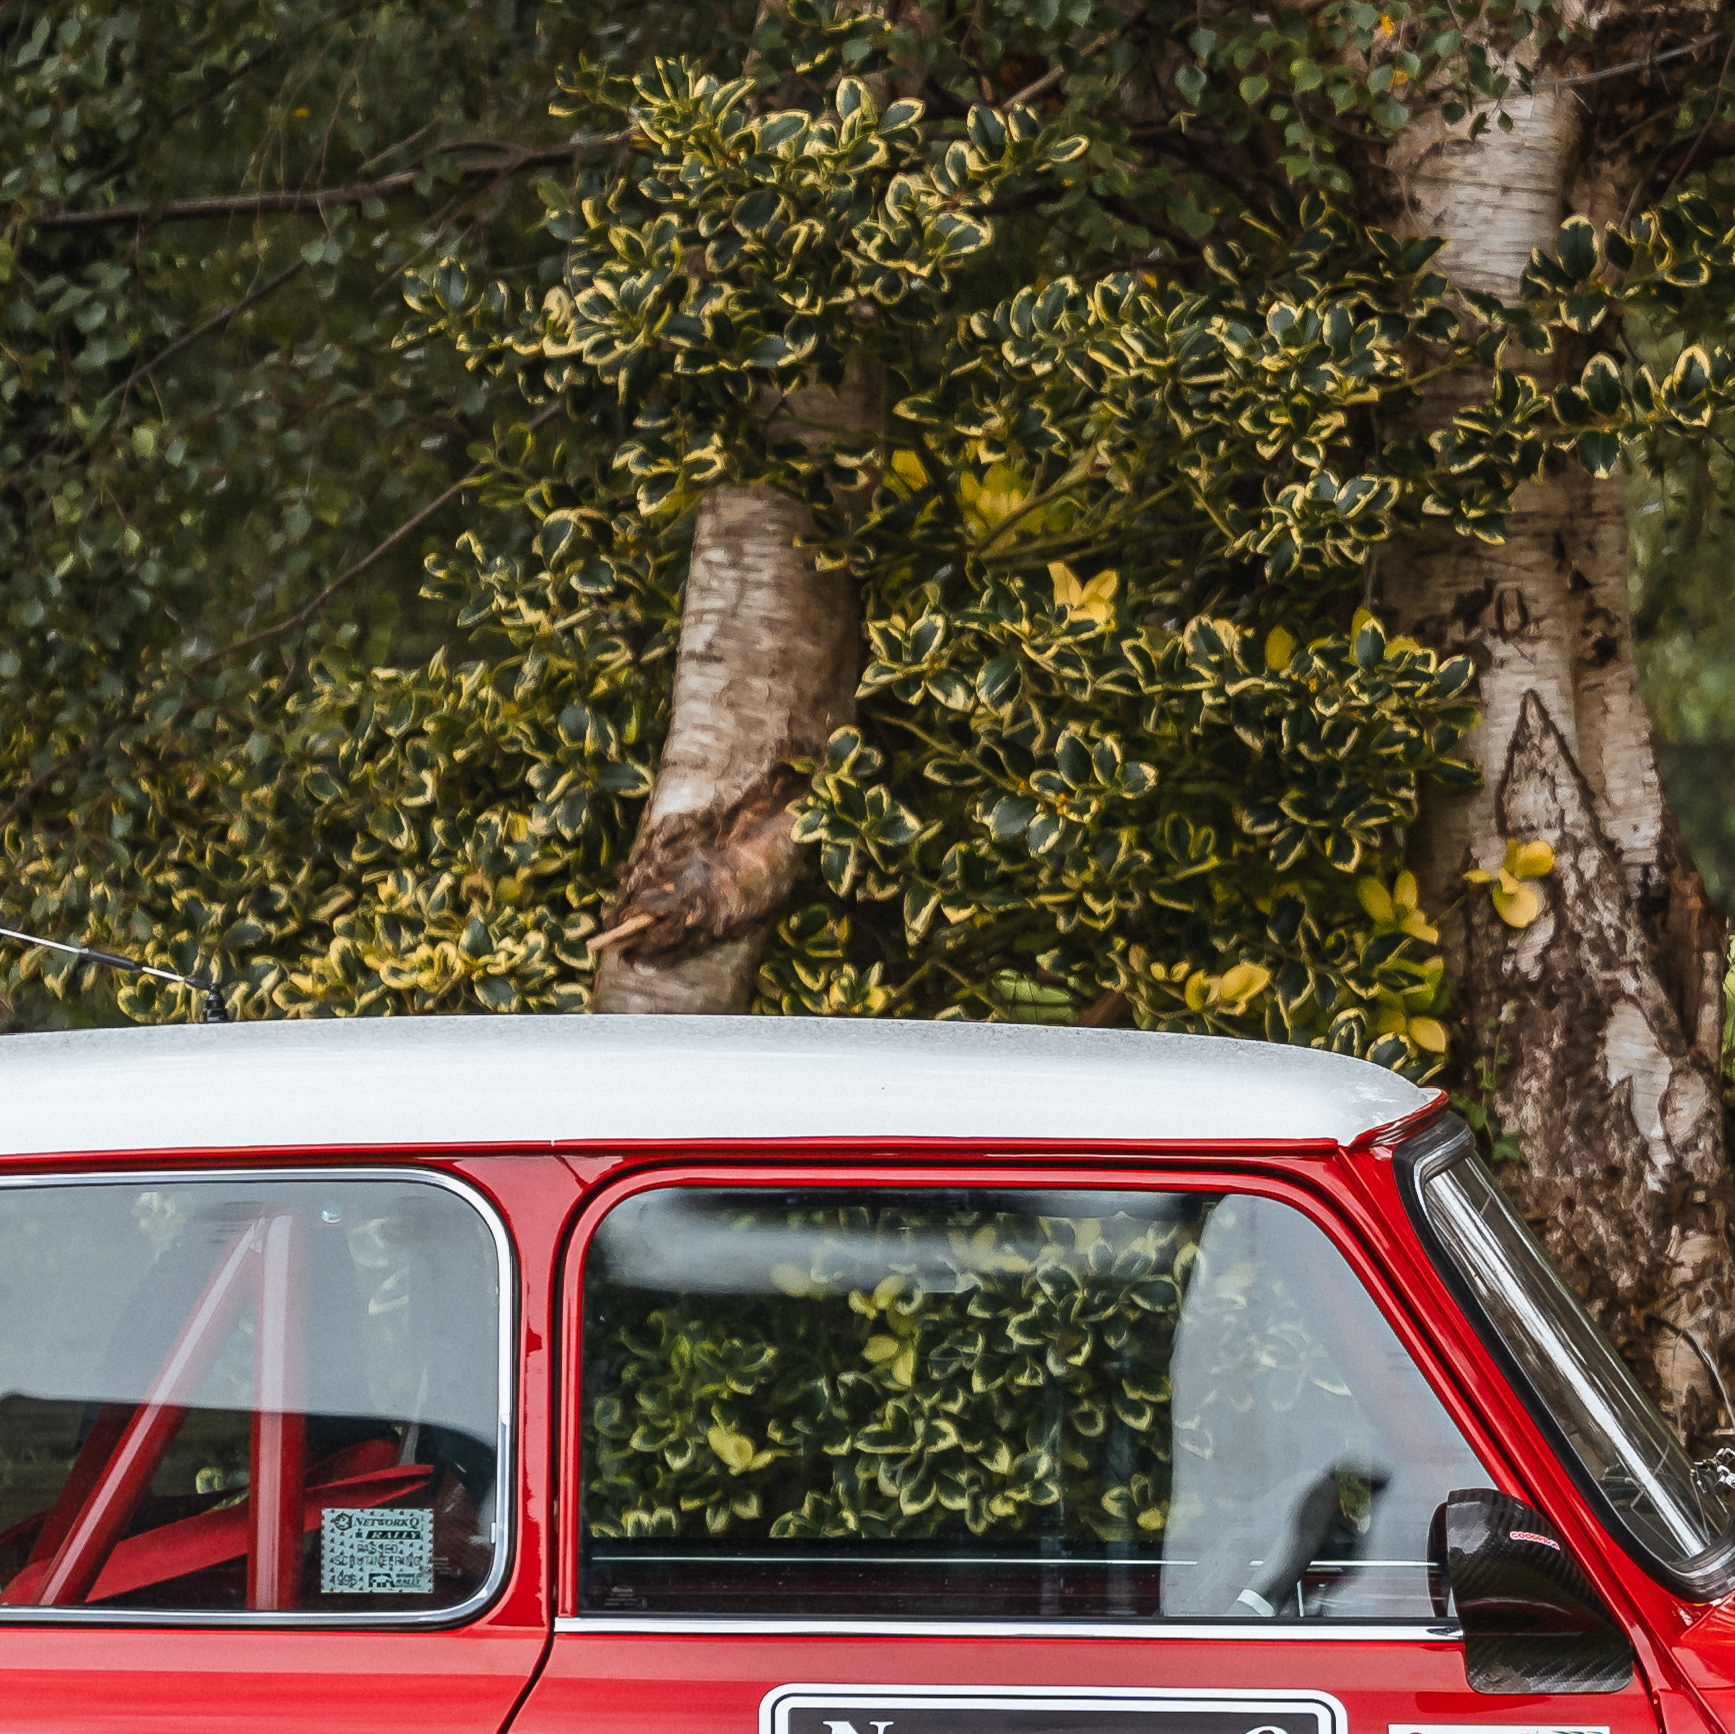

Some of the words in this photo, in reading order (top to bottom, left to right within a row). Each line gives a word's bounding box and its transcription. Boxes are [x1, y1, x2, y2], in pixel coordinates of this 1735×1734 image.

[371, 1531, 418, 1539] RALLY
[357, 1544, 398, 1554] PASSED
[334, 1555, 421, 1566] SCRUTINEERING
